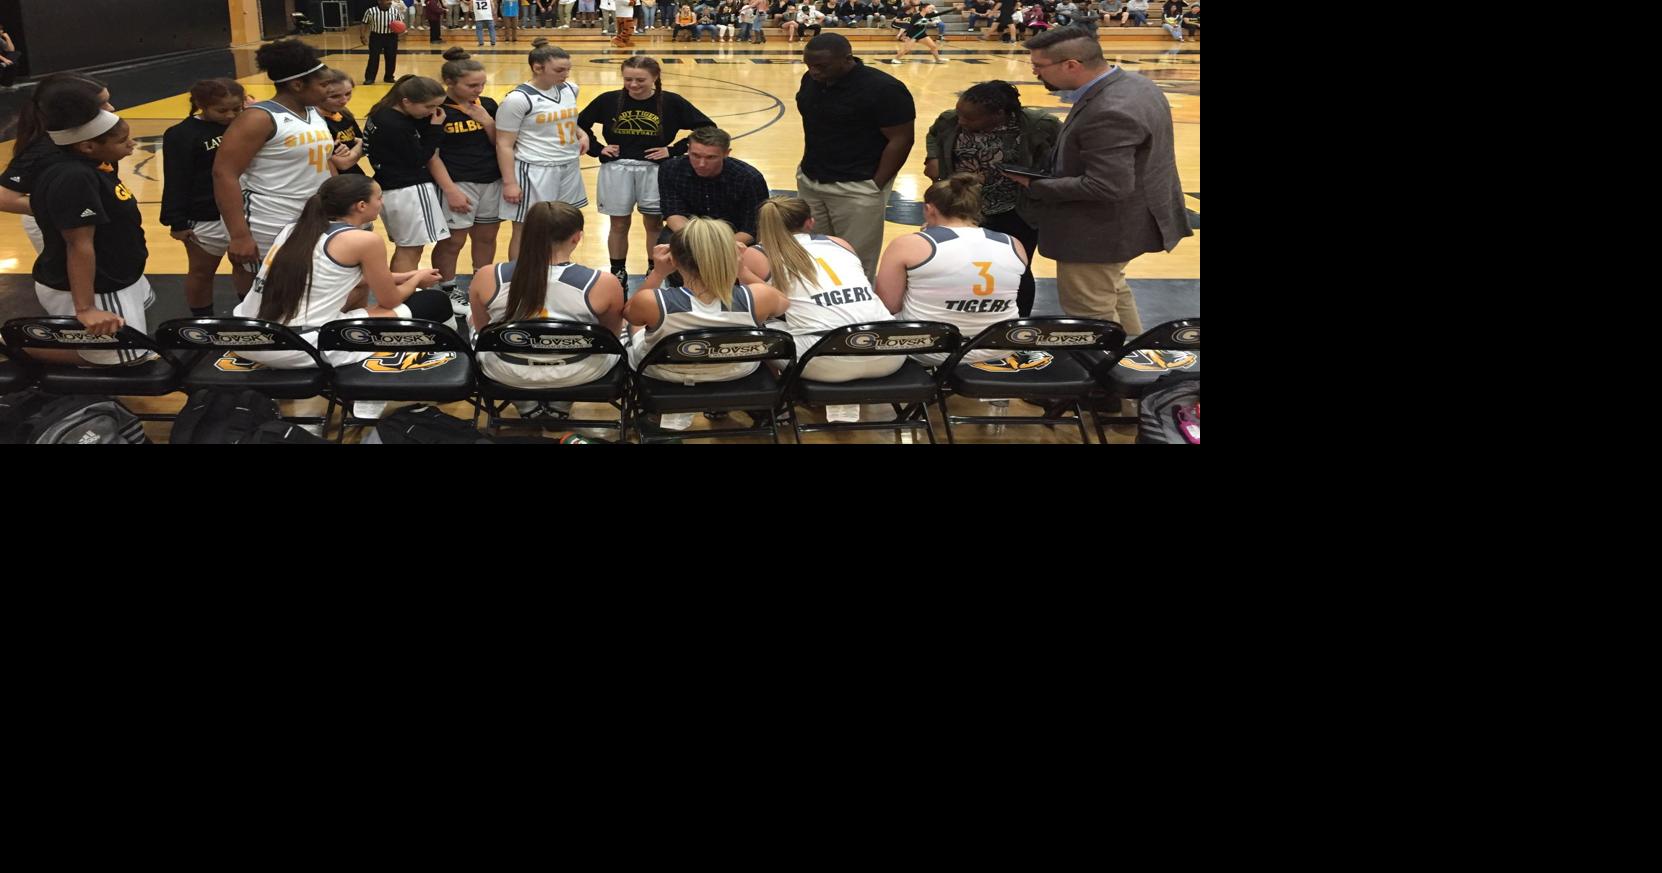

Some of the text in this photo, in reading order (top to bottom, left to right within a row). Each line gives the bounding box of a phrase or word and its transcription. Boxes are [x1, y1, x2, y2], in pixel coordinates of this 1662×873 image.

[476, 1, 488, 10] 12
[971, 261, 995, 296] 3
[810, 286, 873, 307] TIGERS
[945, 298, 1012, 313] TIGERS
[179, 327, 274, 344] GLOVSKY
[340, 327, 436, 345] GLOVSKY
[499, 330, 595, 347] GLOVSKY
[845, 332, 941, 349] GLOVSKY
[1006, 327, 1102, 345] GLOVSKY
[677, 340, 773, 357] GLOVSKY
